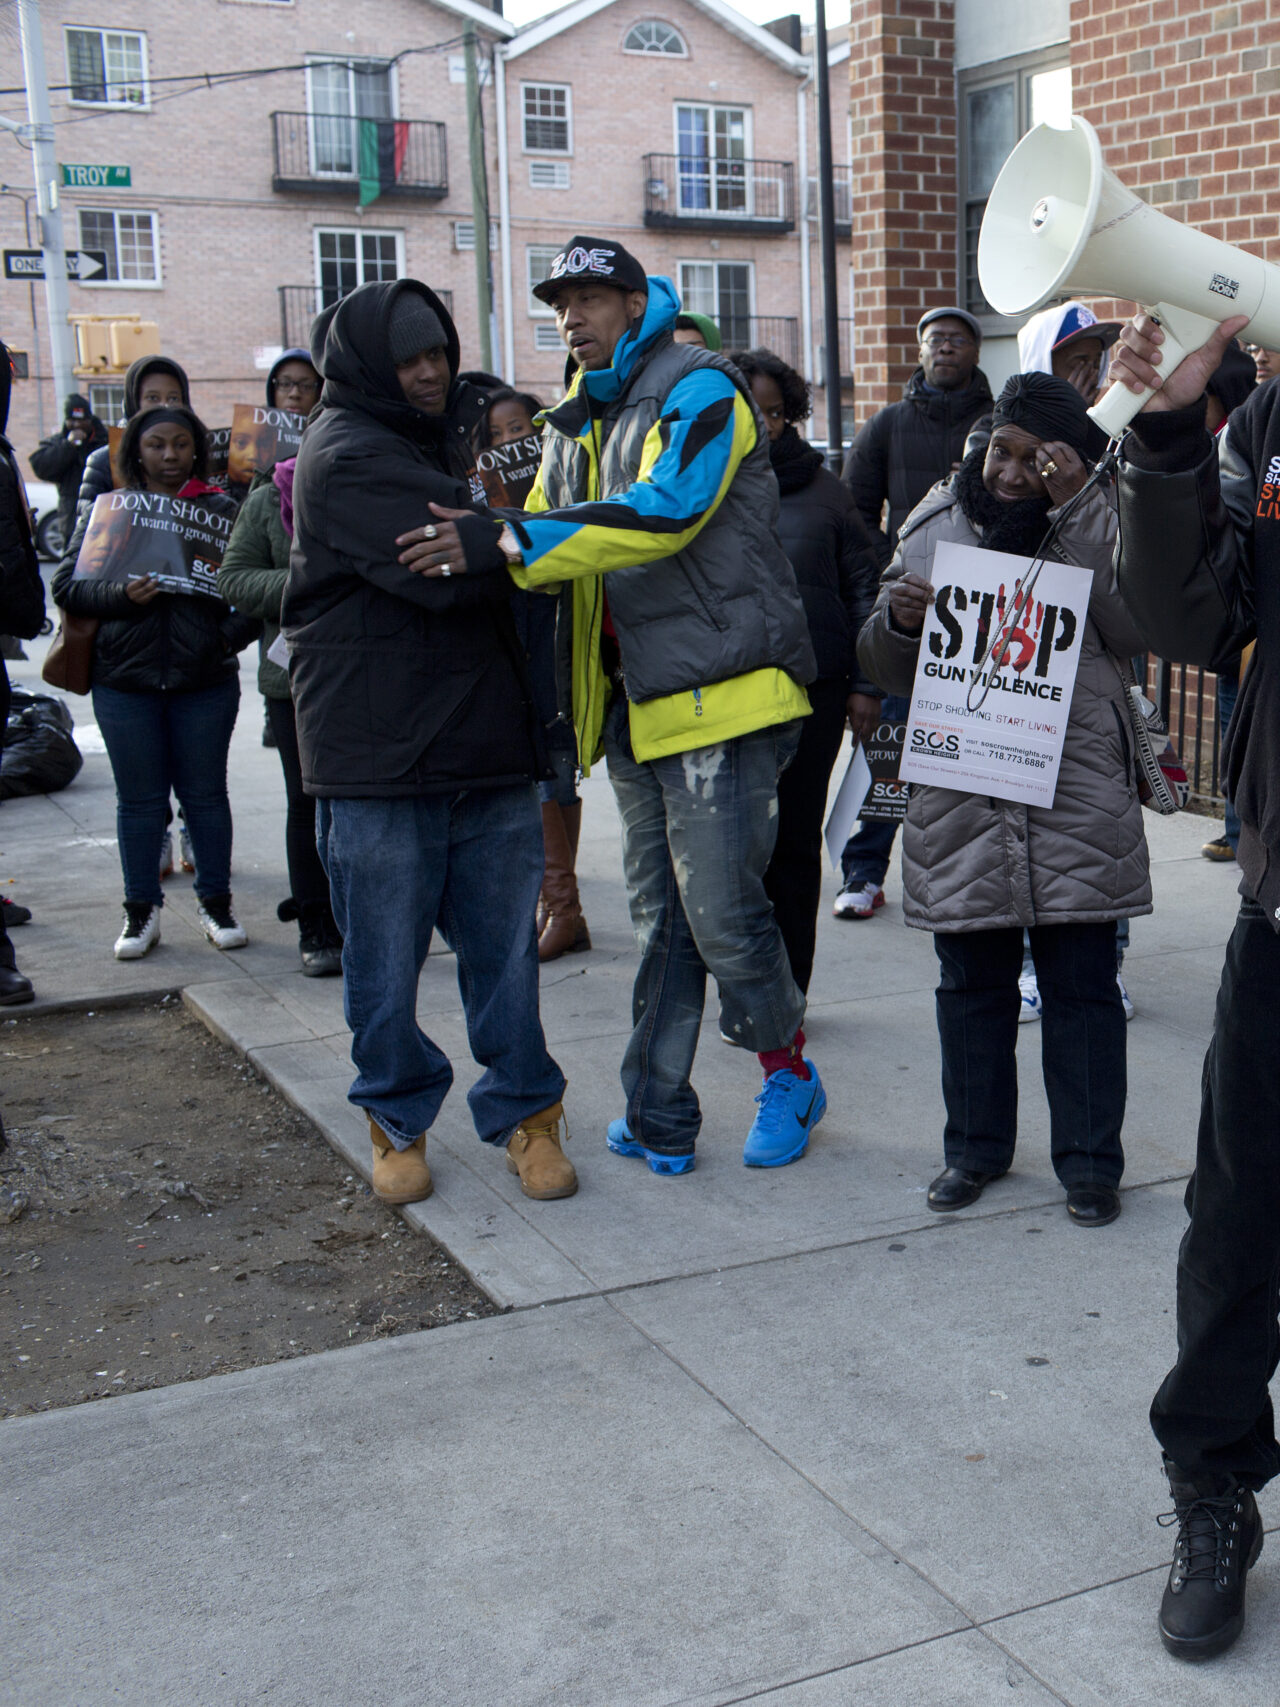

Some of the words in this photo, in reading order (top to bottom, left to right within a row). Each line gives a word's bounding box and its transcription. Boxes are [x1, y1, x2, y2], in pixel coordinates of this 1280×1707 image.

[67, 166, 109, 186] TROY
[14, 258, 44, 271] ONE
[550, 246, 616, 279] ZOE
[1210, 280, 1238, 299] HORN
[253, 408, 308, 431] DON'T
[277, 429, 282, 442] I
[475, 440, 523, 473] ON'T
[498, 469, 507, 485] I
[507, 463, 537, 482] want
[110, 493, 170, 514] DON'T
[170, 499, 233, 537] SHOOT.
[131, 511, 138, 526] I
[140, 516, 169, 531] want
[171, 522, 184, 534] to
[184, 526, 214, 542] grow
[928, 580, 1077, 678] STOP
[924, 662, 966, 683] GUN
[969, 669, 1063, 702] VIOLENCE
[916, 700, 943, 712] STOP
[996, 714, 1025, 728] START
[911, 728, 961, 753] S.O.S.
[980, 740, 1054, 762] soscrownheights.org
[866, 749, 899, 764] grow
[912, 747, 933, 756] CROWN
[933, 750, 959, 760] HEIGHTS
[988, 750, 1046, 769] 718.773.6886
